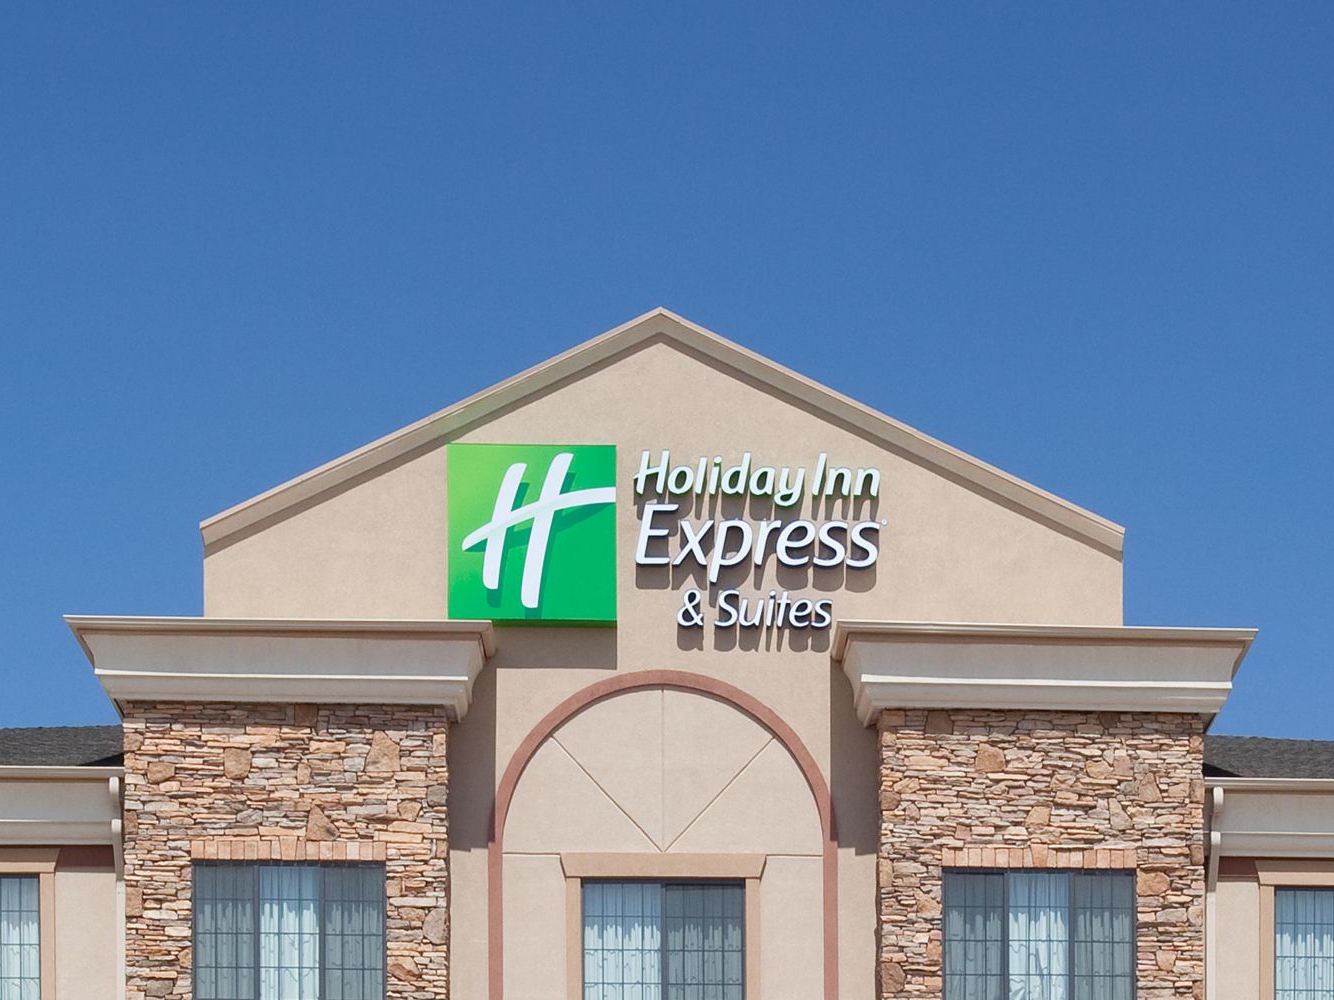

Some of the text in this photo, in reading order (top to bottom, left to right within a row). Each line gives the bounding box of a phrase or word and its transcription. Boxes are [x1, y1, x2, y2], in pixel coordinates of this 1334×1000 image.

[633, 450, 881, 507] Holiday Inn
[635, 503, 881, 584] Express
[677, 589, 833, 629] & Suites
